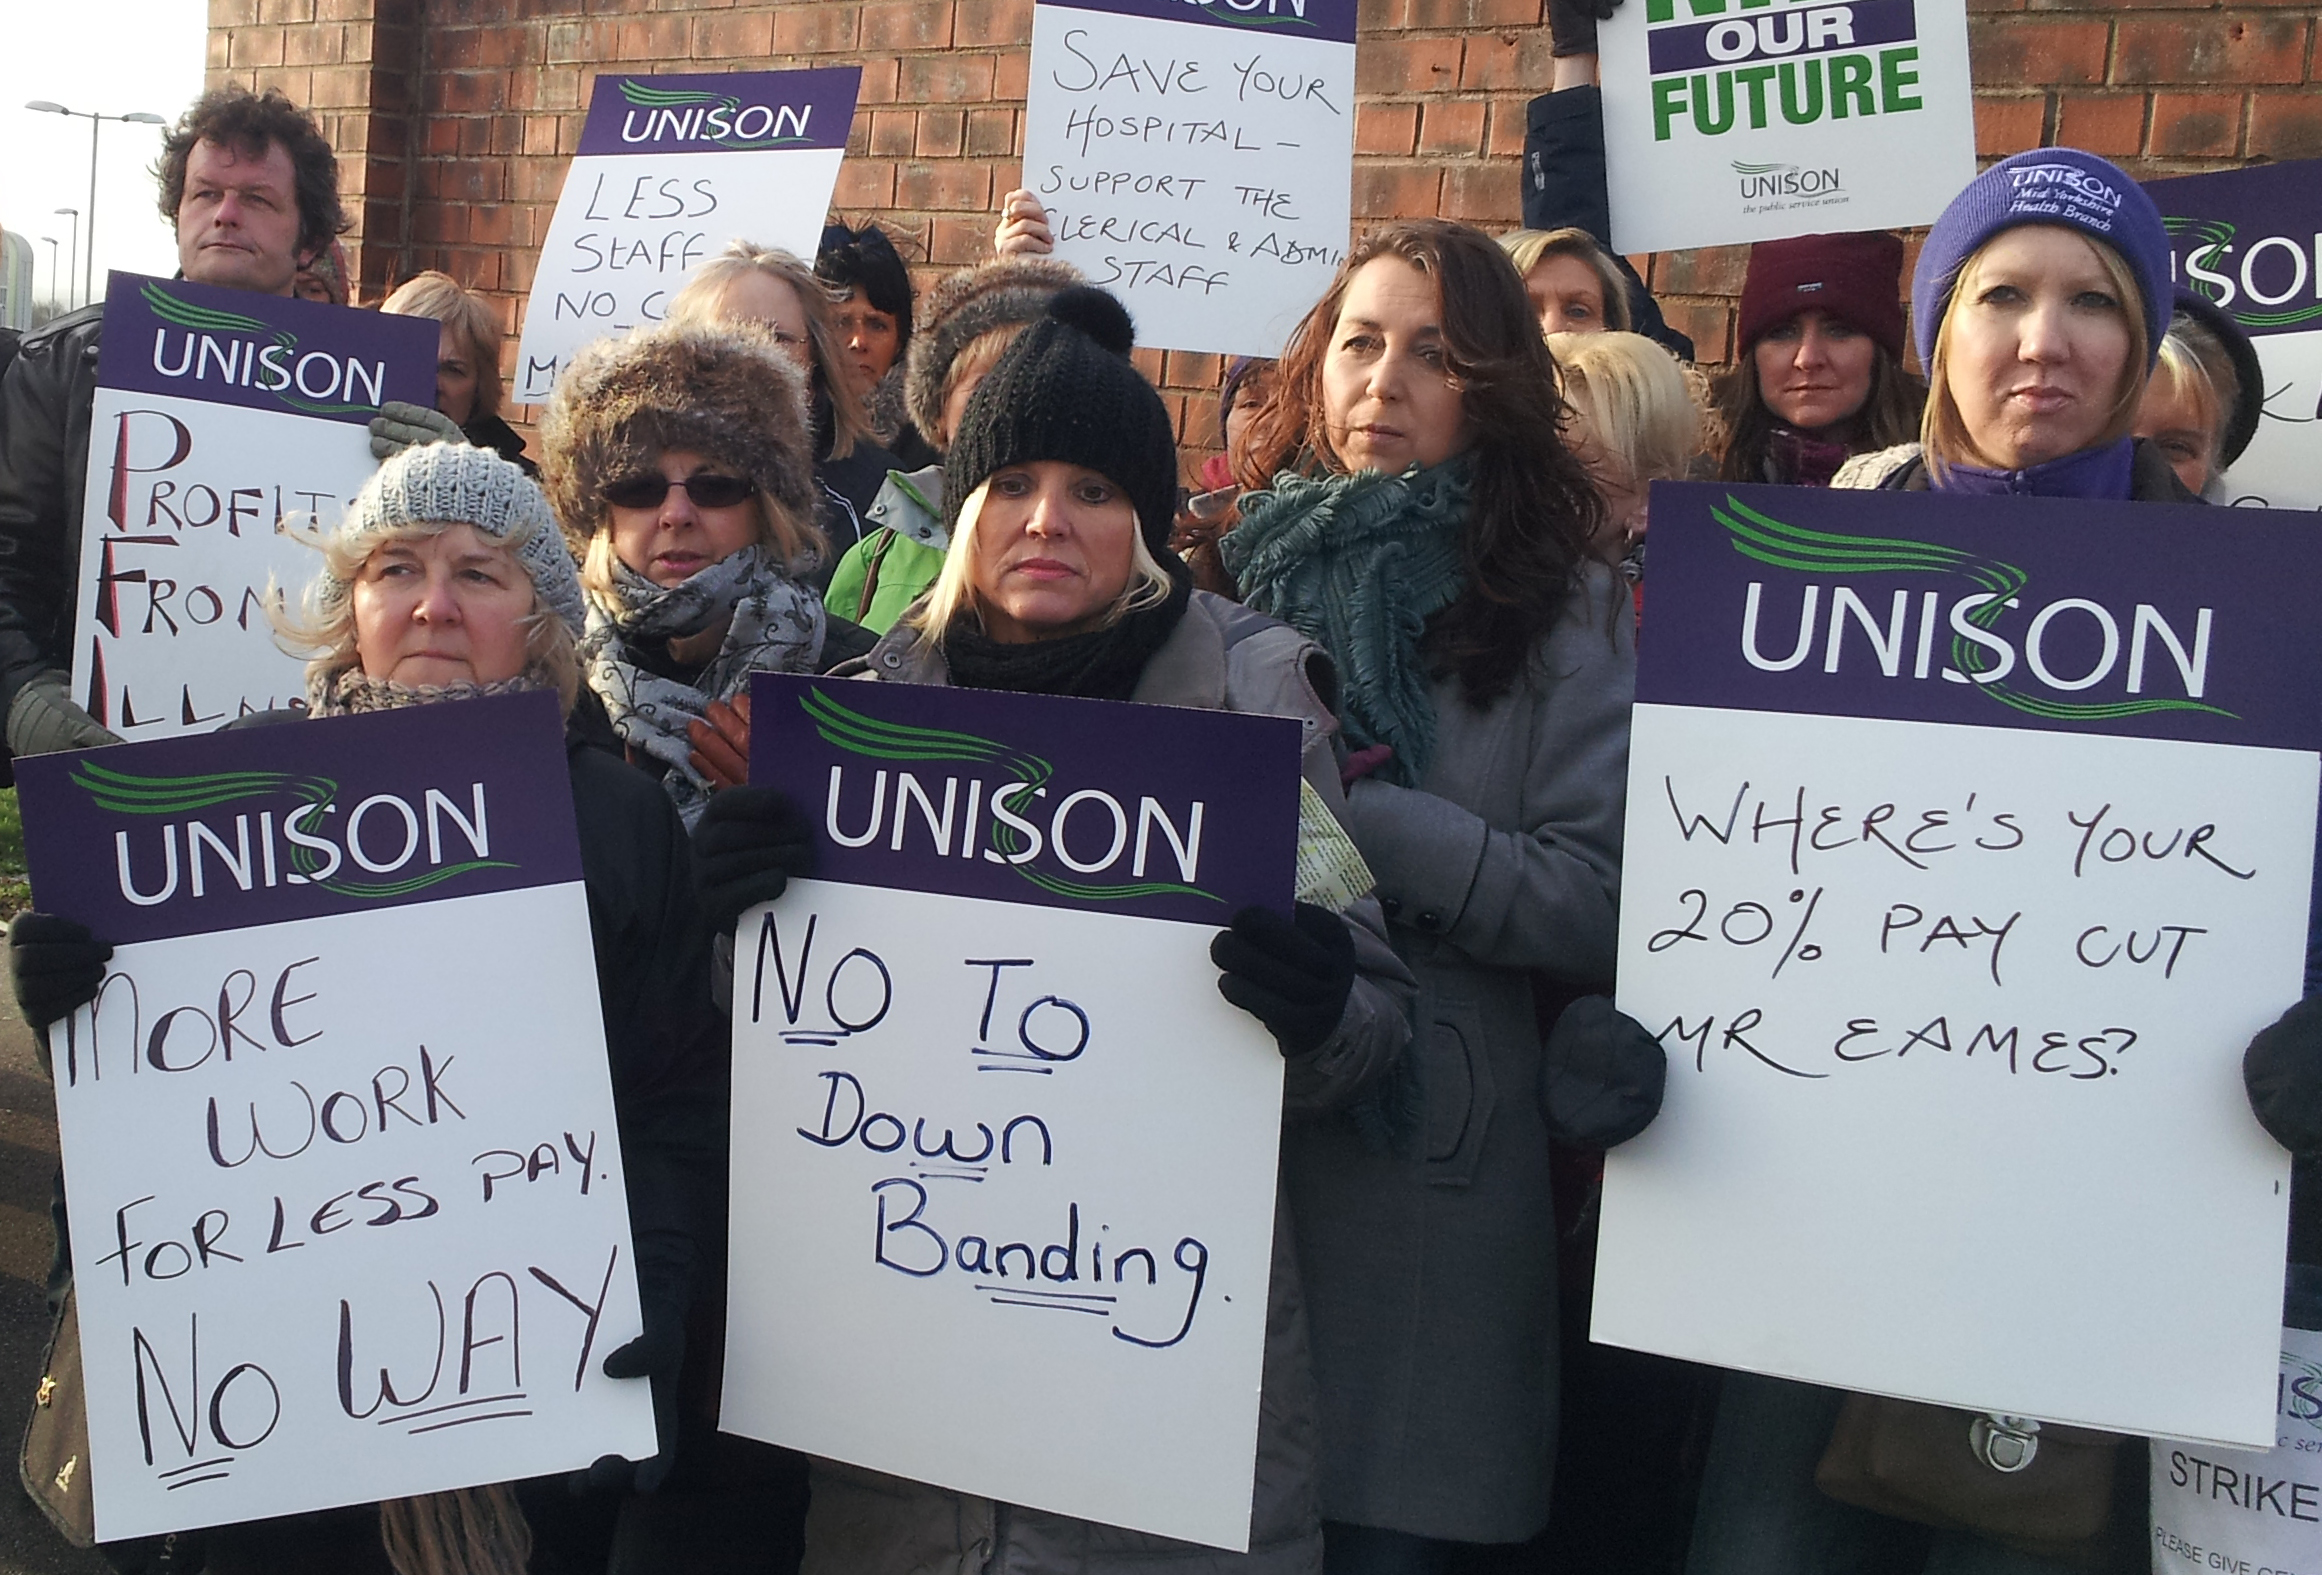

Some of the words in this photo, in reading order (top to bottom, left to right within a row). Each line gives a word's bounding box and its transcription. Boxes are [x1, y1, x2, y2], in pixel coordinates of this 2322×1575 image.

[1705, 6, 1855, 61] OUR
[1053, 29, 1207, 95] SAVE
[1233, 55, 1341, 115] YOUR
[1651, 46, 1923, 141] FUTURE
[621, 104, 813, 142] UNISON
[1066, 104, 1261, 157] HOSPITAL
[585, 173, 717, 220] LESS
[1040, 165, 1206, 200] SUPPORT
[1235, 186, 1299, 220] THE
[1741, 168, 1839, 198] UNISON
[1743, 205, 1757, 214] the
[1759, 202, 1785, 214] public
[1789, 199, 1820, 209] service
[1822, 197, 1850, 206] union
[2009, 200, 2059, 213] Health
[2063, 204, 2112, 231] Branch
[2013, 170, 2121, 207] UNISON
[2015, 187, 2050, 199] Mid
[2054, 188, 2114, 216] Yorkshire
[1093, 256, 1230, 295] STAFF
[1228, 231, 1242, 252] &
[556, 290, 616, 321] NO
[153, 328, 386, 406] UNISON
[107, 410, 358, 537] PROFIT
[1740, 581, 2213, 699] UNISON
[114, 782, 492, 906] UNISON
[824, 765, 1204, 882] UNISON
[1665, 775, 2024, 875] WHERE'S
[2068, 803, 2256, 879] YOUR
[1647, 887, 1823, 979] 20%
[1880, 903, 2022, 987] PAY
[2077, 925, 2208, 979] CUT
[65, 956, 325, 1087] MORE
[1656, 1007, 1831, 1079] MR
[1834, 1016, 2138, 1080] EAMES?
[208, 1045, 466, 1168] WORK
[96, 1196, 243, 1286] FOR
[268, 1176, 440, 1254] LESS
[133, 1312, 281, 1466] NO
[338, 1244, 619, 1419] WAY
[2170, 1450, 2320, 1522] STRIKE
[2156, 1526, 2203, 1564] PLEASE
[2208, 1552, 2250, 1575] GIVE
